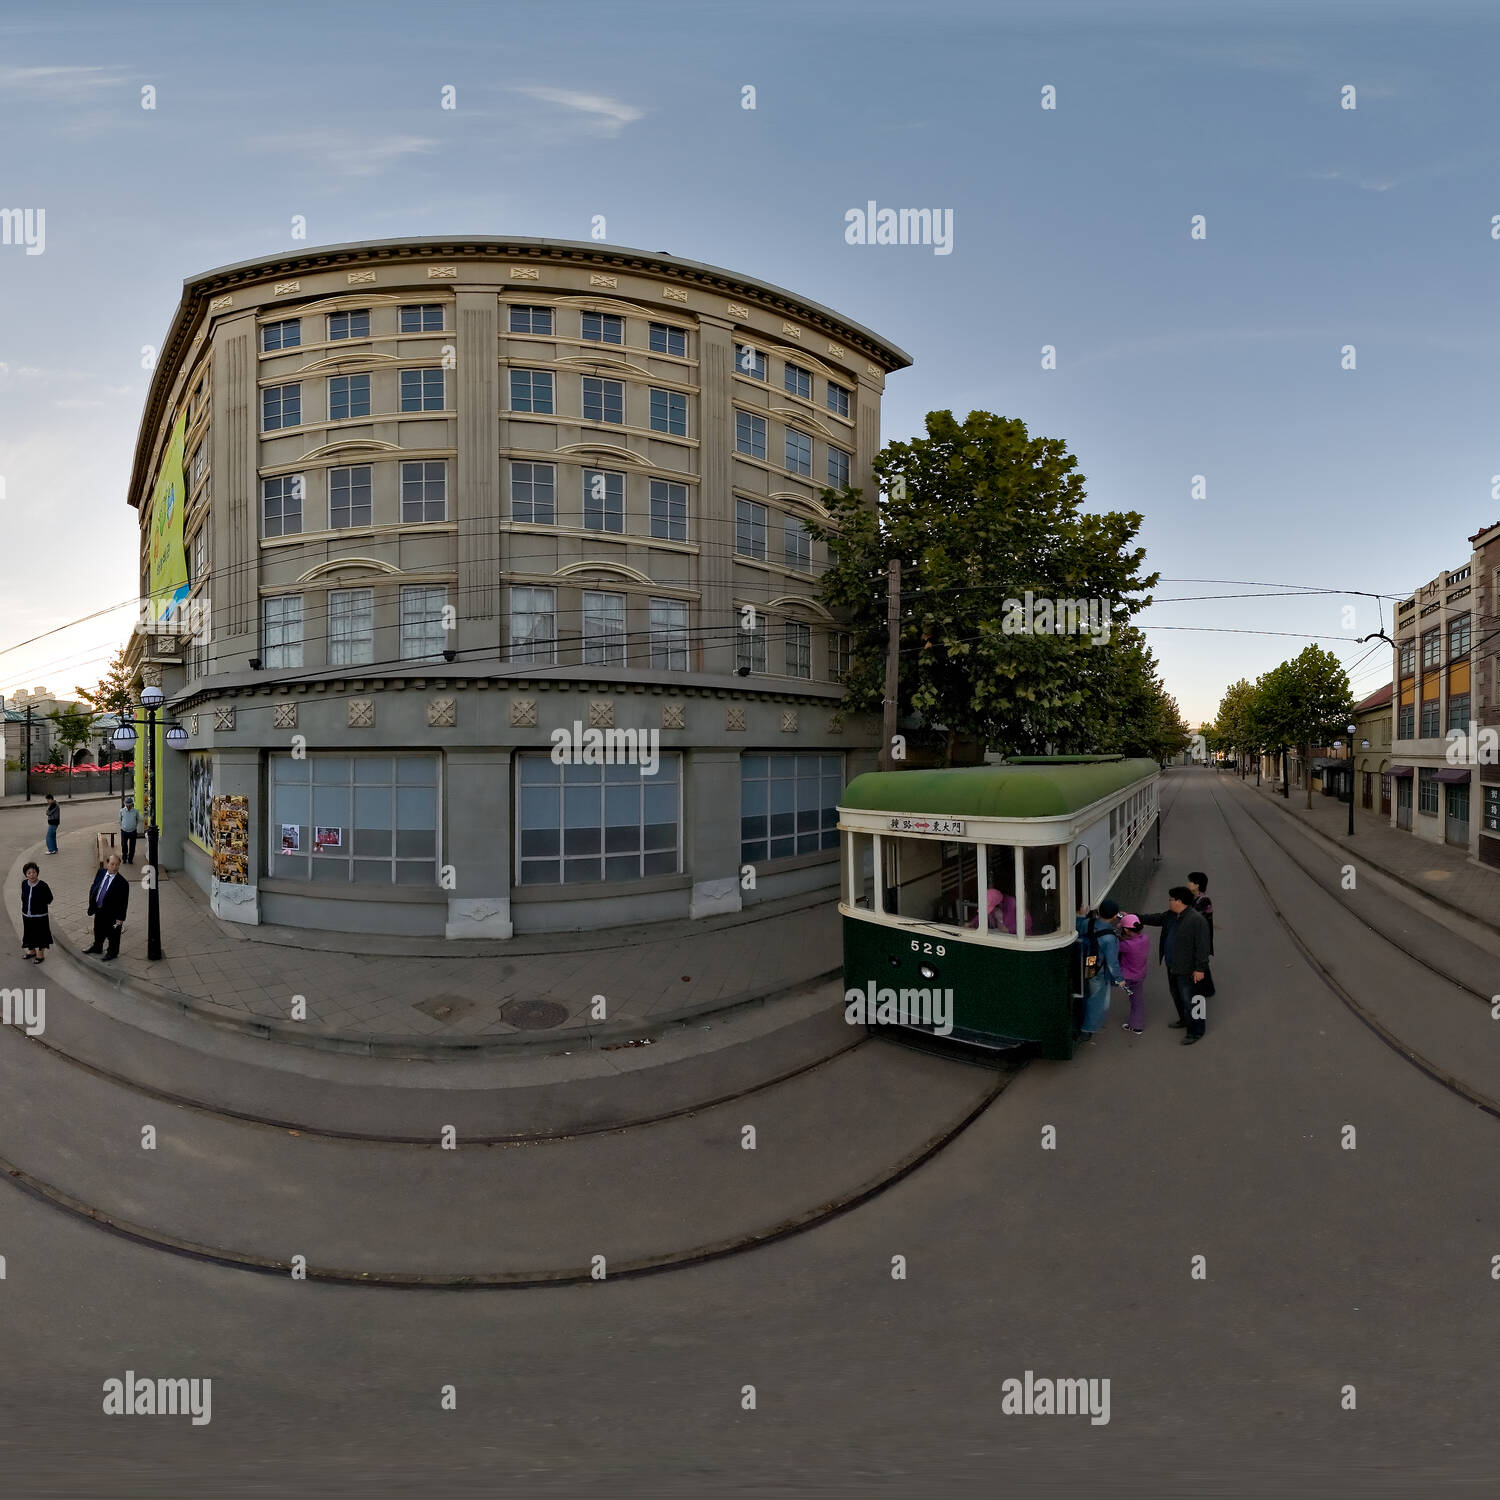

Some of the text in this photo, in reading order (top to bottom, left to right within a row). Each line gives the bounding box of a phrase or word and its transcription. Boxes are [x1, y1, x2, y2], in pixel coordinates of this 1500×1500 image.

[932, 820, 961, 833] 東大門
[911, 940, 946, 957] 529
